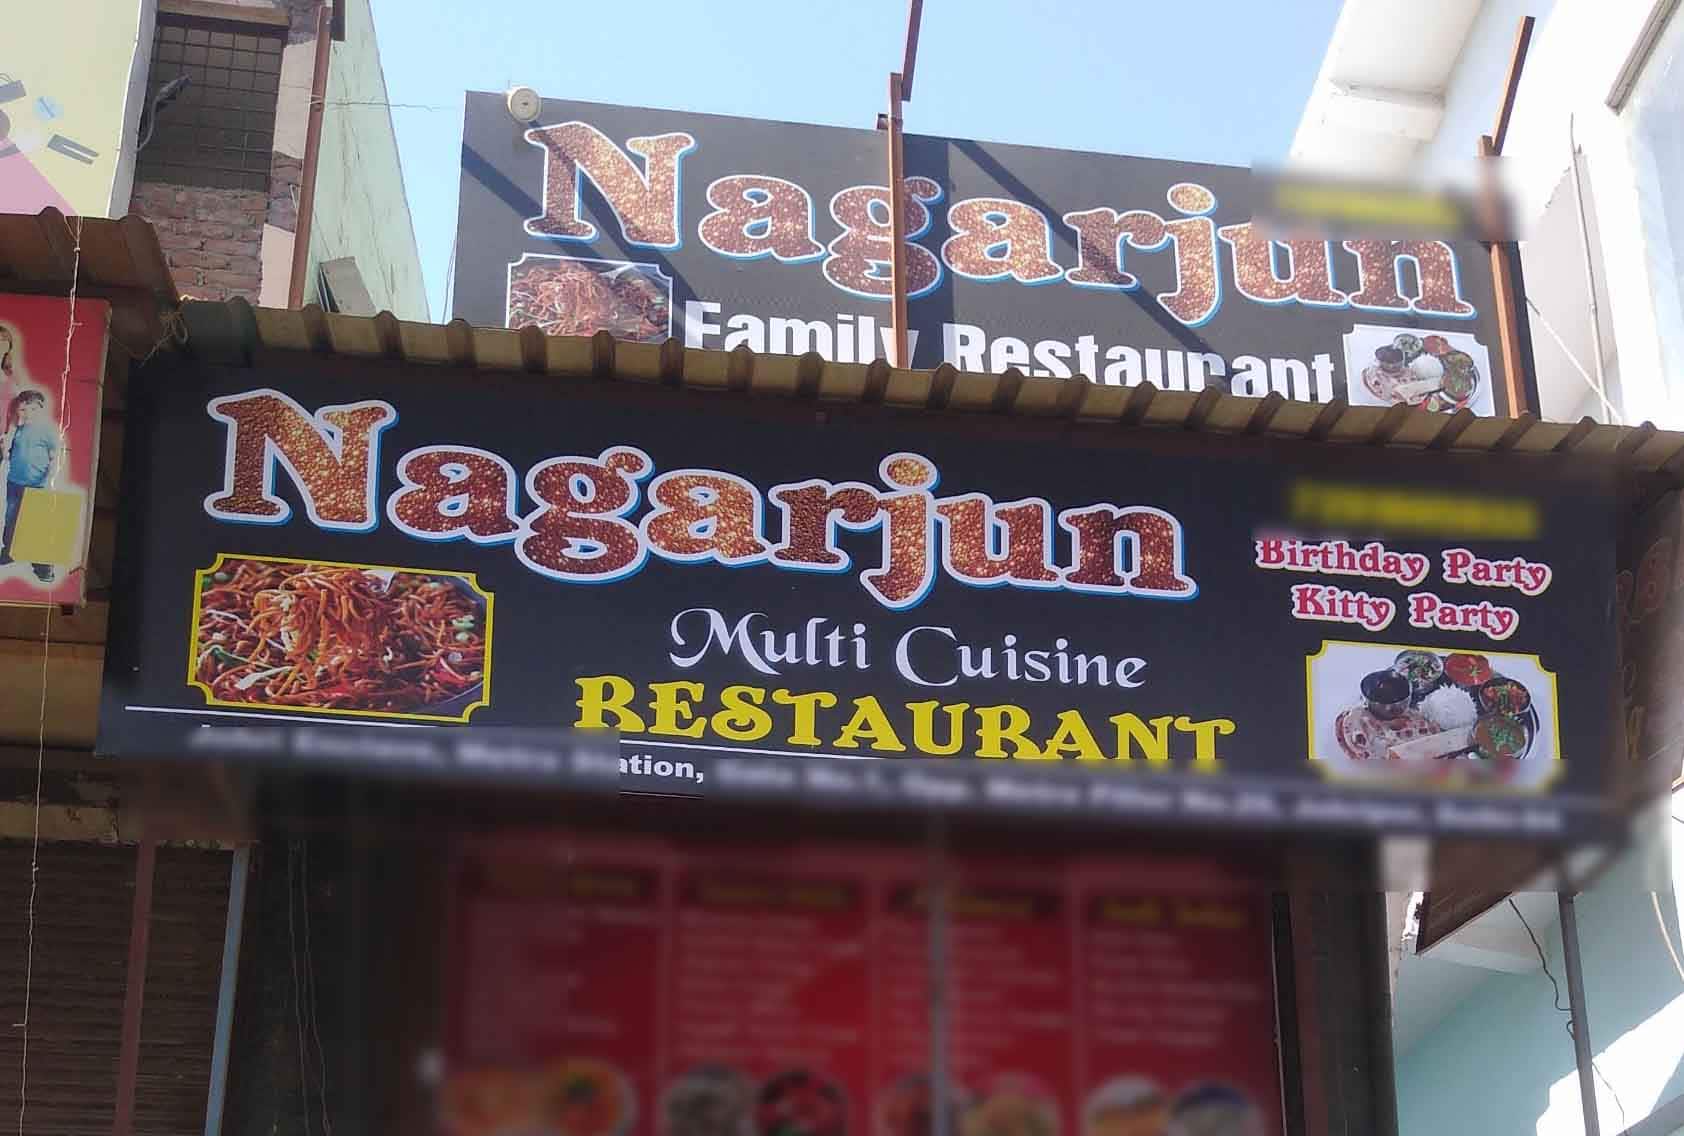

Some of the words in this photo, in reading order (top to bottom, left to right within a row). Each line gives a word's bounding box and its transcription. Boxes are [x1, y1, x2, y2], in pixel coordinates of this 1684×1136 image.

[523, 121, 1478, 328] Nagarjun
[942, 323, 1334, 404] Restaurant
[203, 388, 1199, 611] Nagarjun
[1257, 538, 1429, 586] Birthday
[1443, 549, 1552, 595] Party
[669, 607, 871, 676] Multi
[895, 626, 1149, 689] Cuisine
[1292, 584, 1395, 631] Kitty
[1409, 593, 1518, 640] Party
[574, 675, 1237, 771] RESTAURANT
[617, 754, 705, 784] ation,
